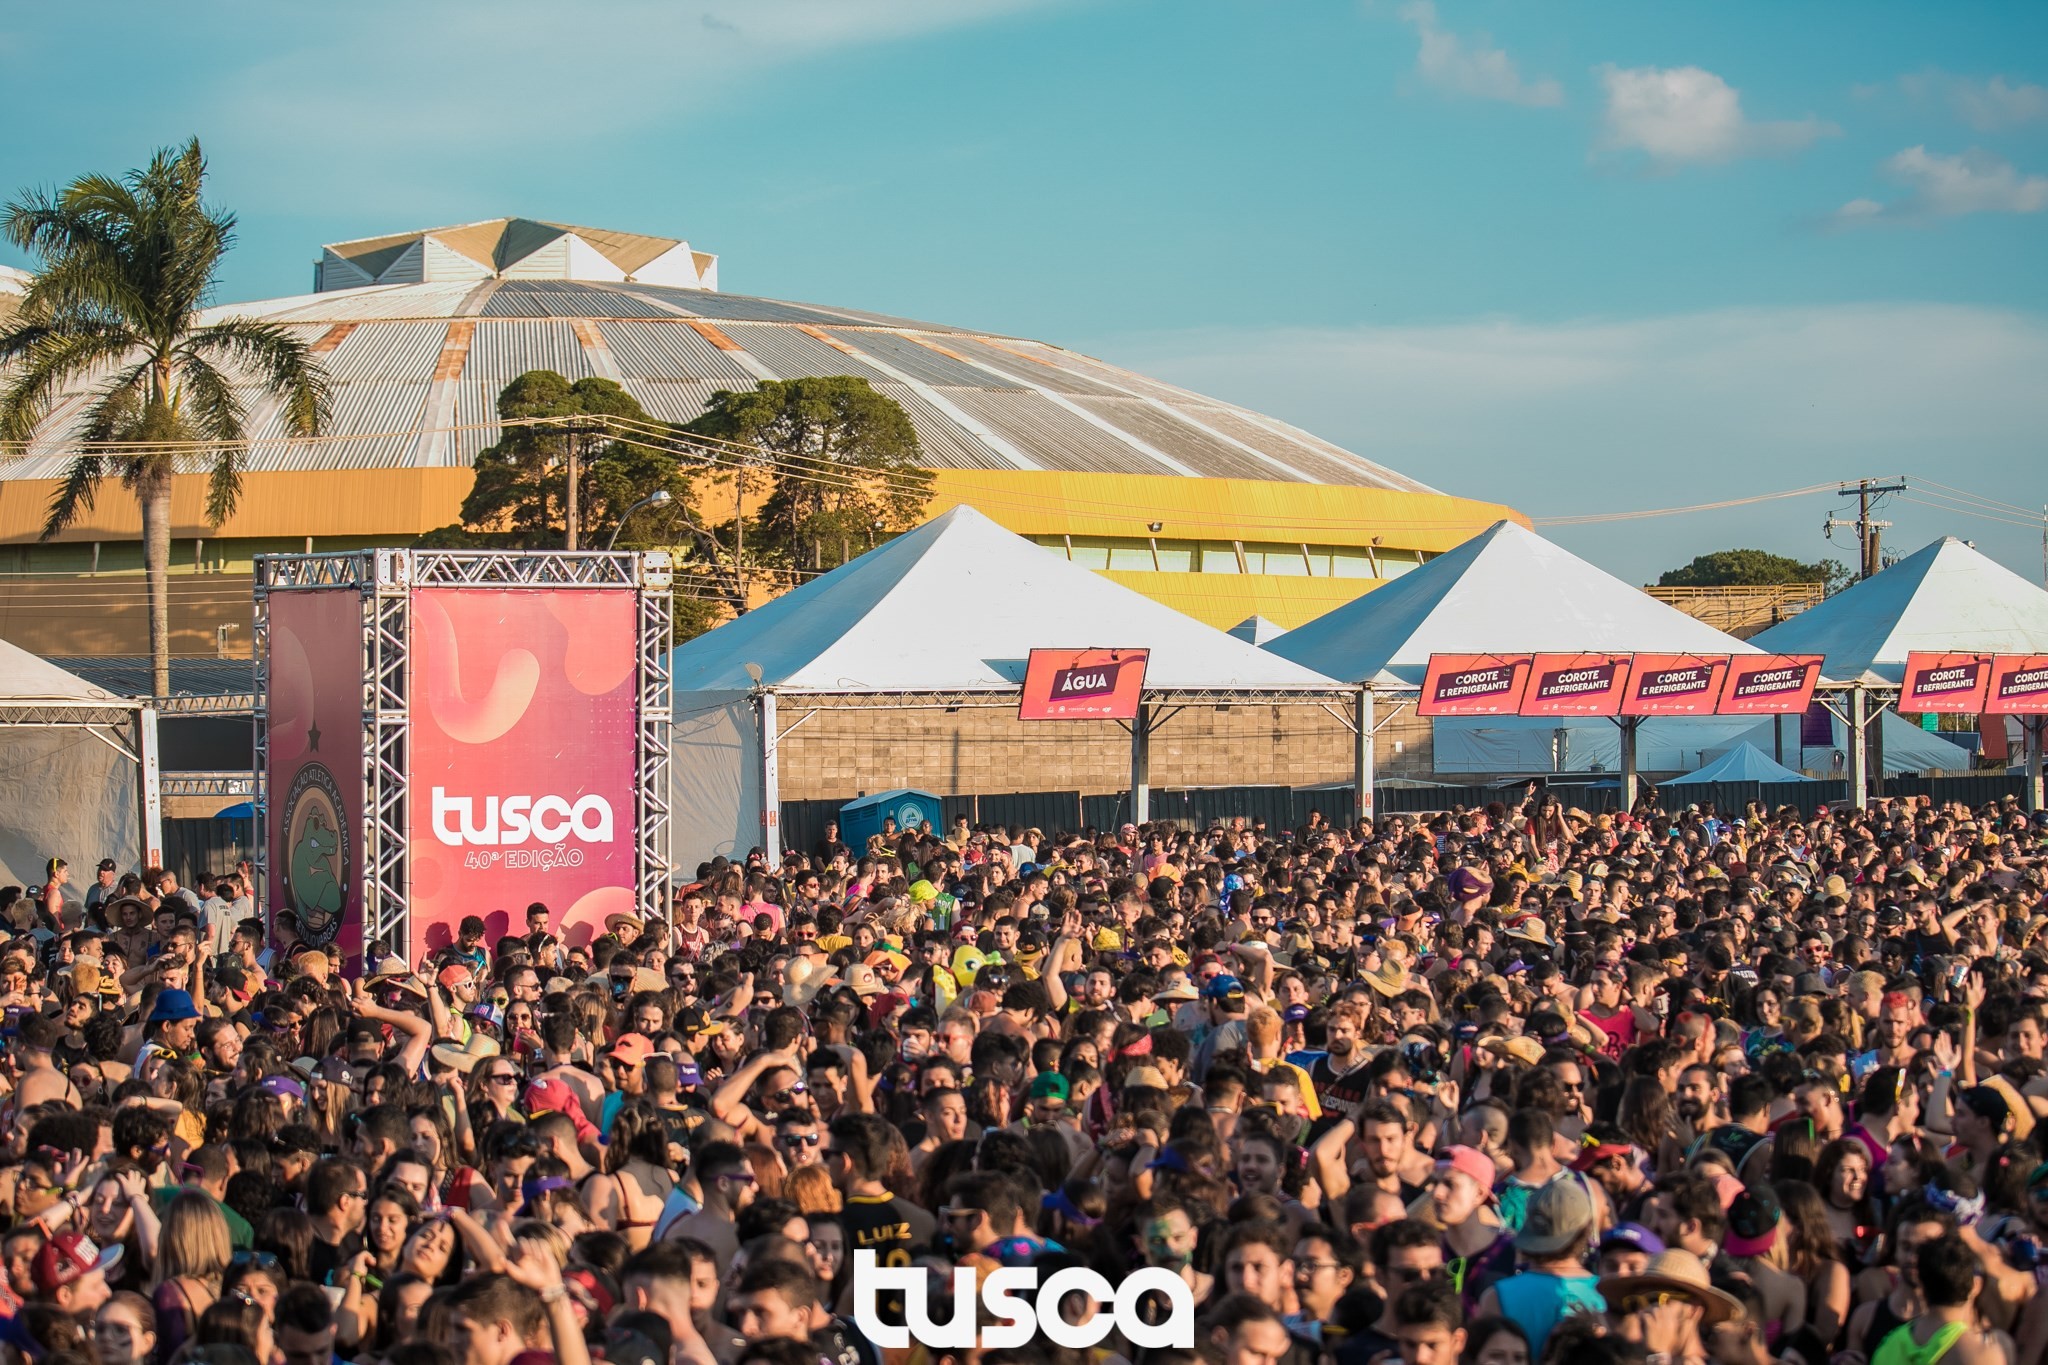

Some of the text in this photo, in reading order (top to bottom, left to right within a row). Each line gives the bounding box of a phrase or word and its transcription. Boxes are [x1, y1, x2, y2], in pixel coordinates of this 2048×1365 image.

[1061, 672, 1107, 691] ÁGUA
[1456, 670, 1499, 685] COROTE
[1558, 670, 1600, 684] COROTE
[1657, 670, 1698, 684] COROTE
[1753, 670, 1793, 684] COROTE
[1929, 668, 1966, 682] COROTE
[2014, 670, 2048, 684] COROTE
[1440, 680, 1509, 698] E REFRIGERANTE
[1542, 679, 1609, 695] E REFRIGERANTE
[1642, 680, 1707, 695] E REFRIGERANTE
[1738, 679, 1802, 695] E REFRIGERANTE
[1916, 678, 1975, 693] E REFRIGERANTE
[2002, 687, 2008, 695] E
[432, 787, 614, 846] tusca
[504, 843, 584, 871] EDIÇÃO
[857, 1222, 912, 1245] LUIZ
